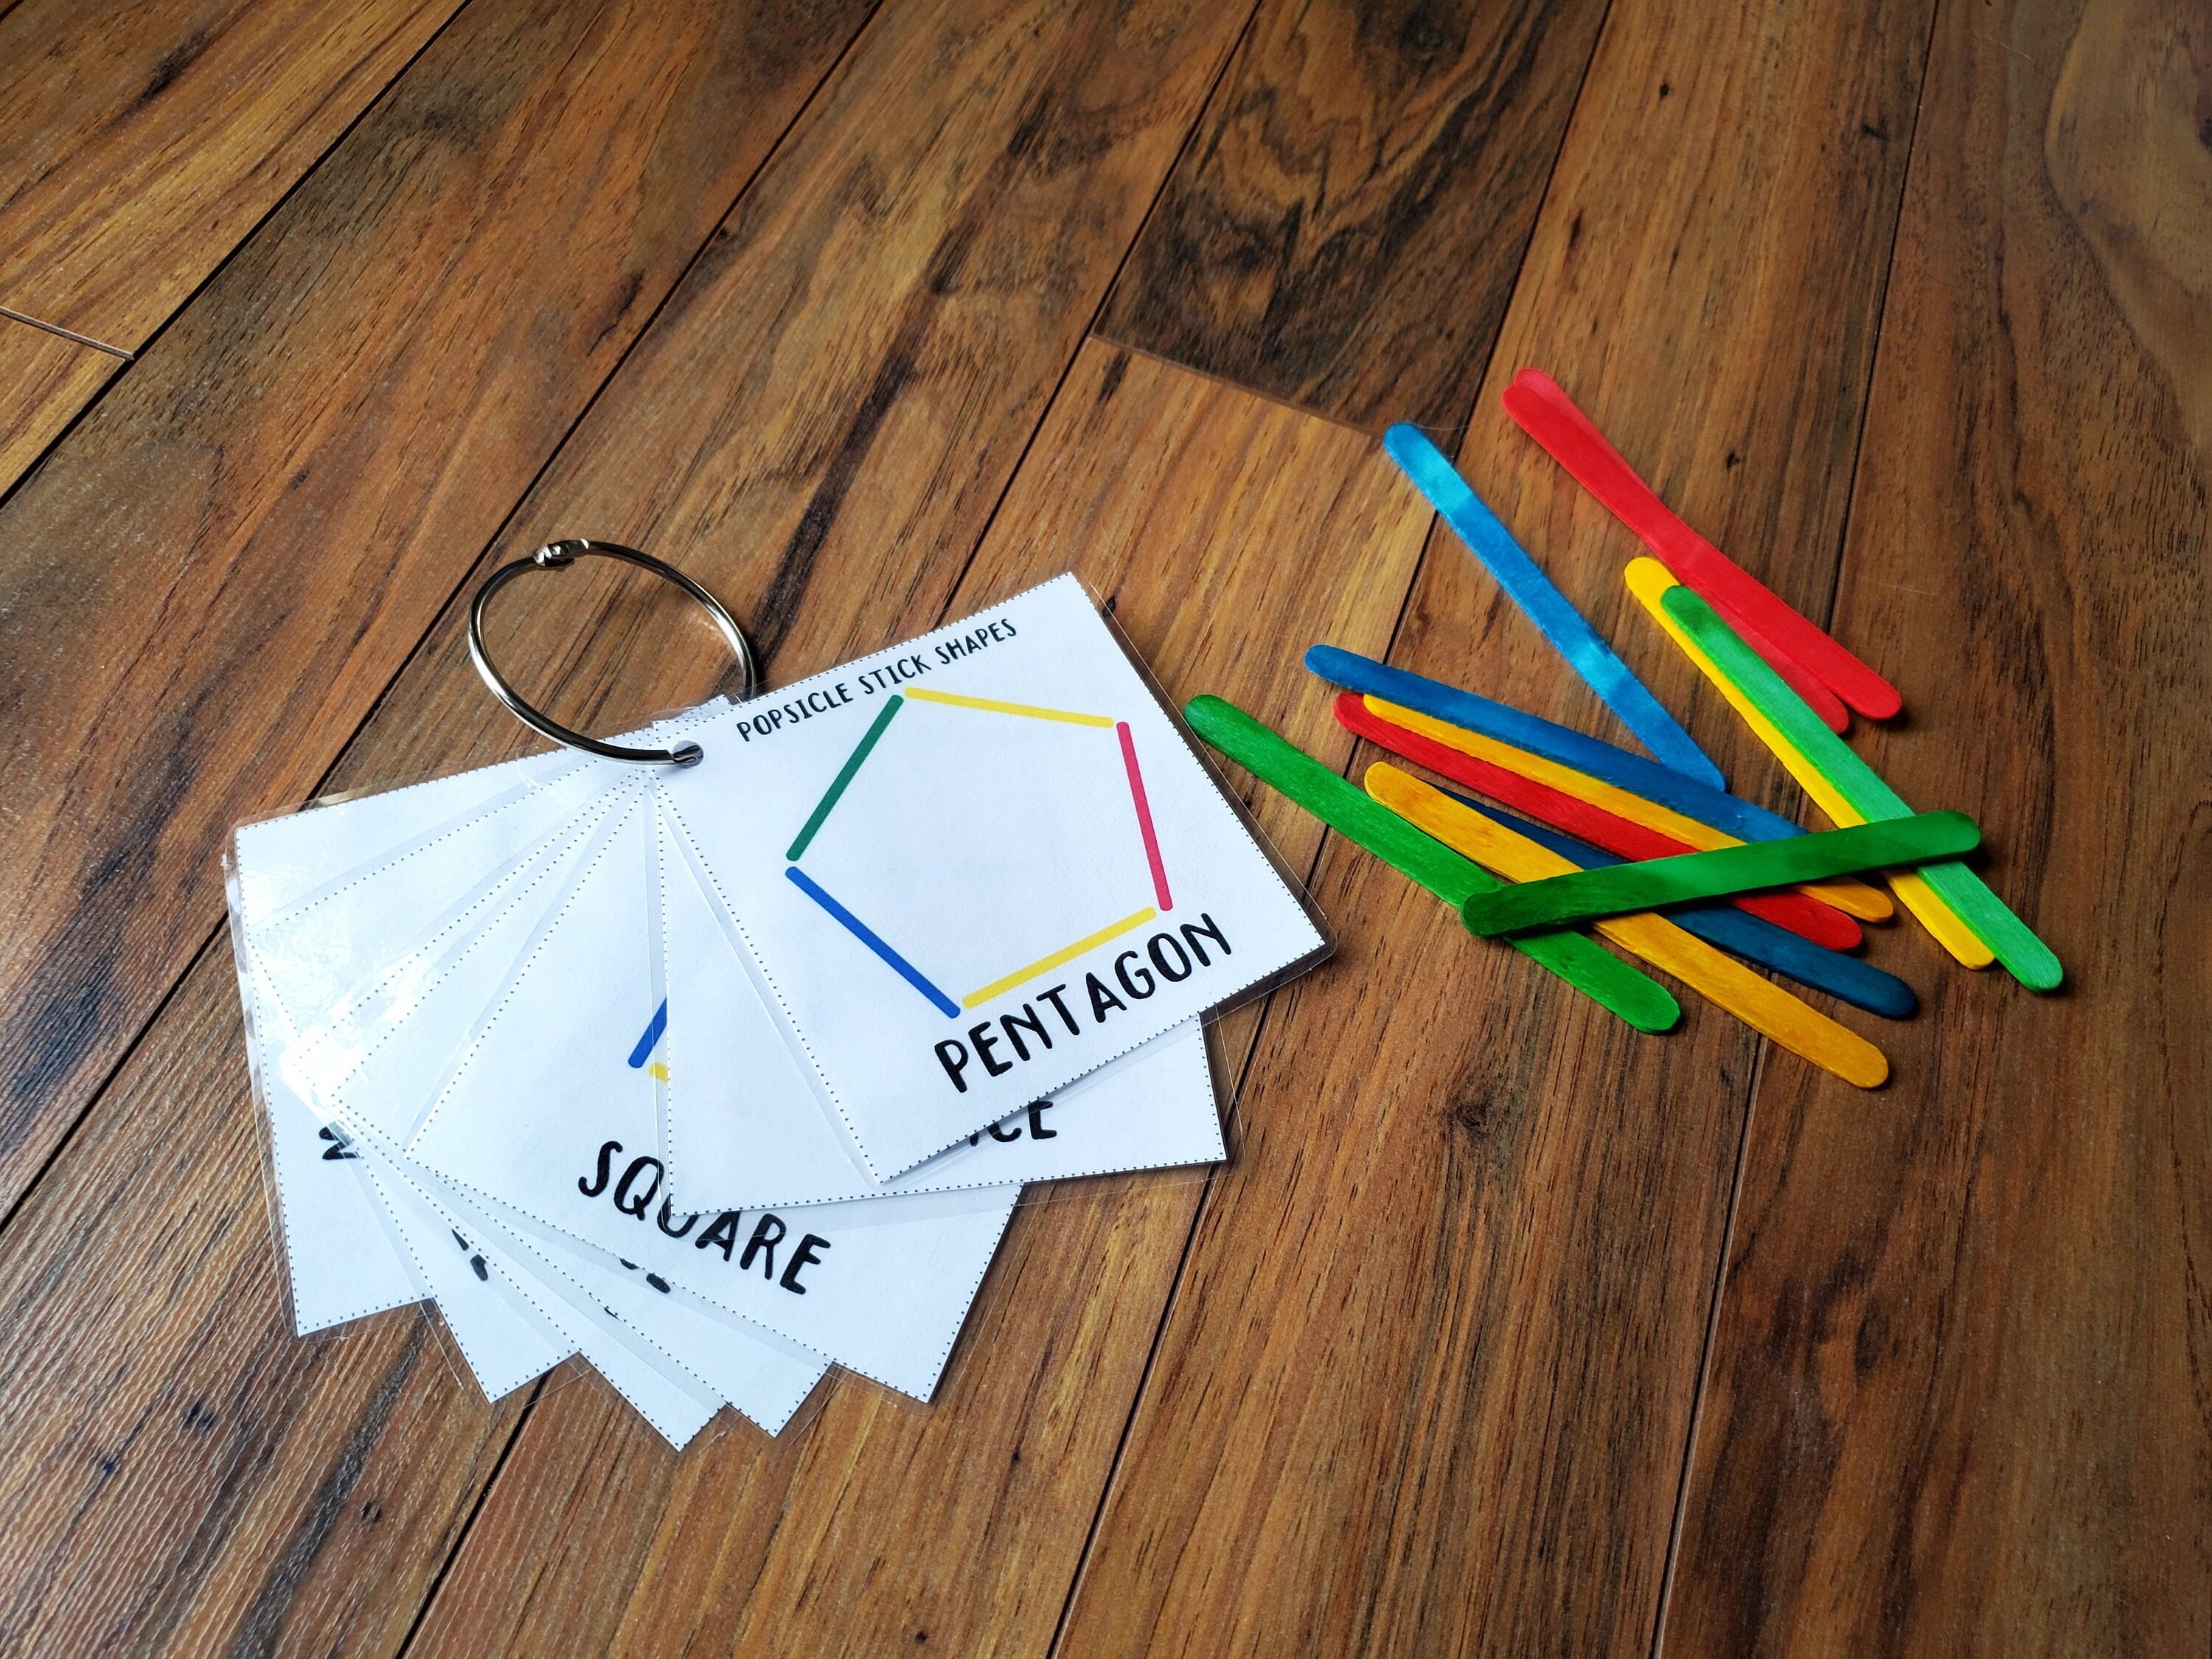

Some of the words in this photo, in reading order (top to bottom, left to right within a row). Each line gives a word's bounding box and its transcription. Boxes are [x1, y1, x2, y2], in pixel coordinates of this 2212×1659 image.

[736, 683, 854, 742] POPSICLE
[858, 654, 932, 695] STICK
[935, 618, 1018, 665] SHAPES
[933, 912, 1232, 1093] PENTAGON
